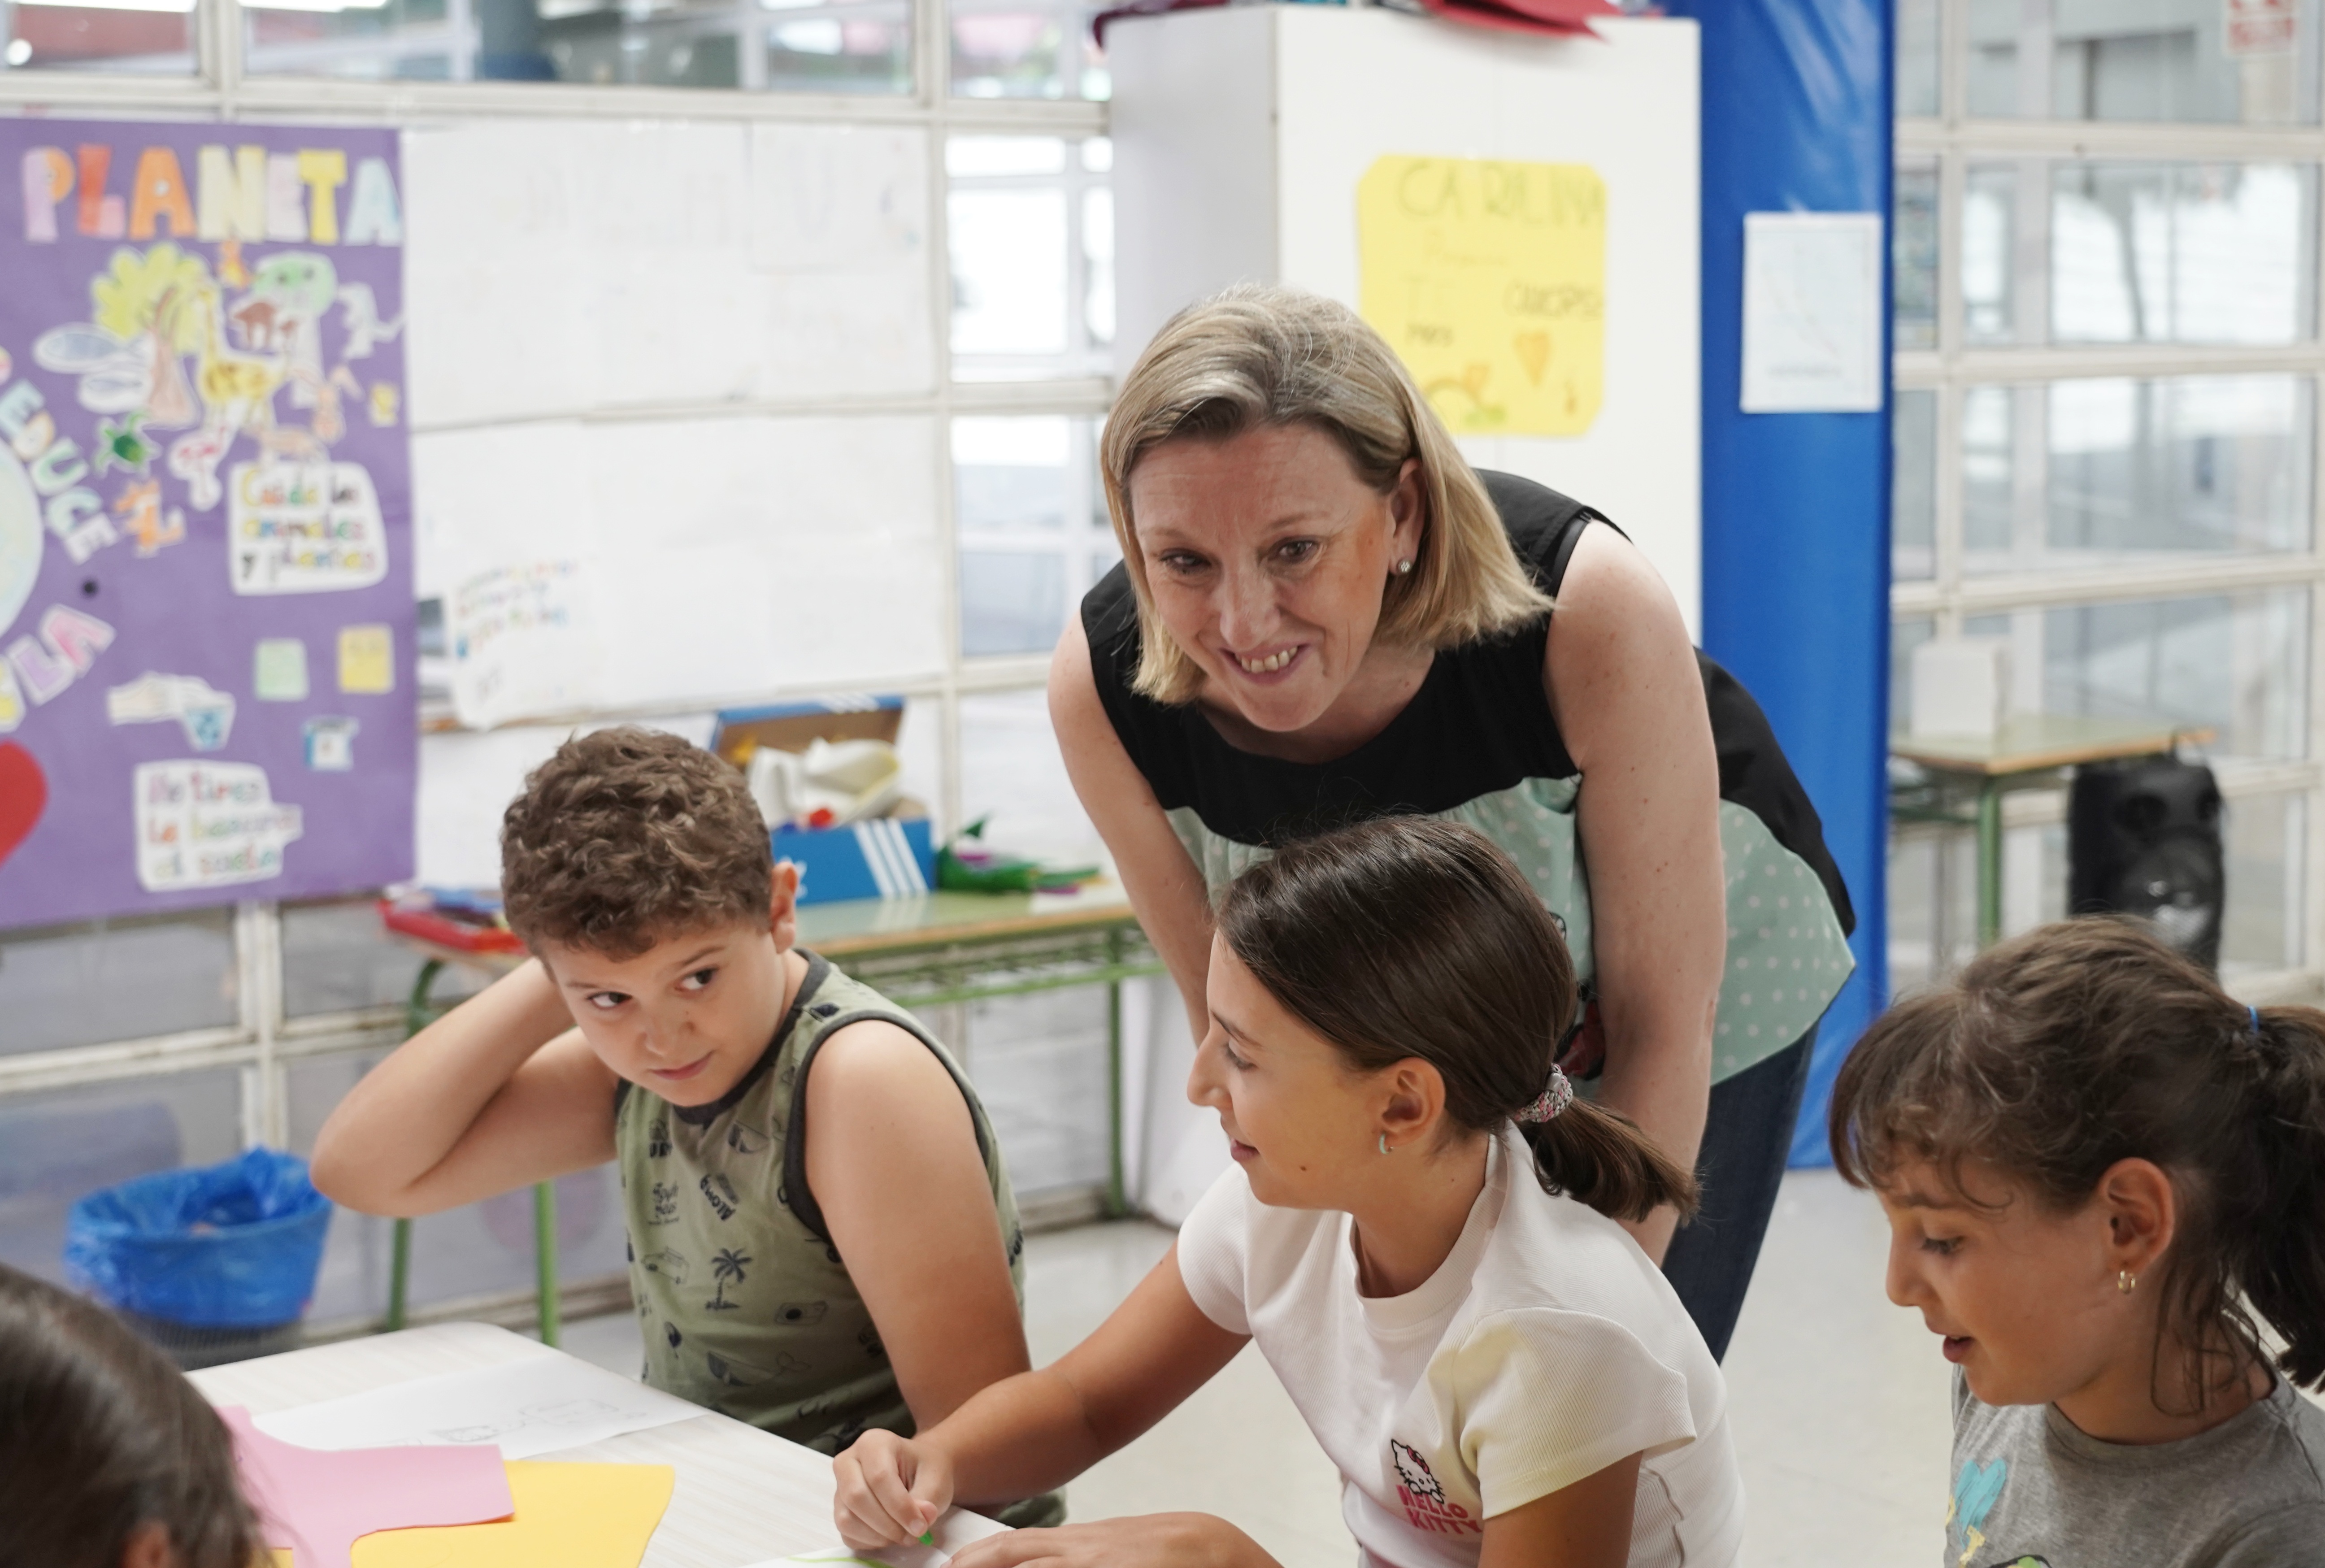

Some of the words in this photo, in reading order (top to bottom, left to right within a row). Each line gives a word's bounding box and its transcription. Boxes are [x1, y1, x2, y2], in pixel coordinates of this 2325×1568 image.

[22, 144, 403, 245] PLANETA
[0, 345, 117, 564] EDUCE
[1395, 1485, 1468, 1519] HELLO
[1405, 1507, 1483, 1534] KITTY
